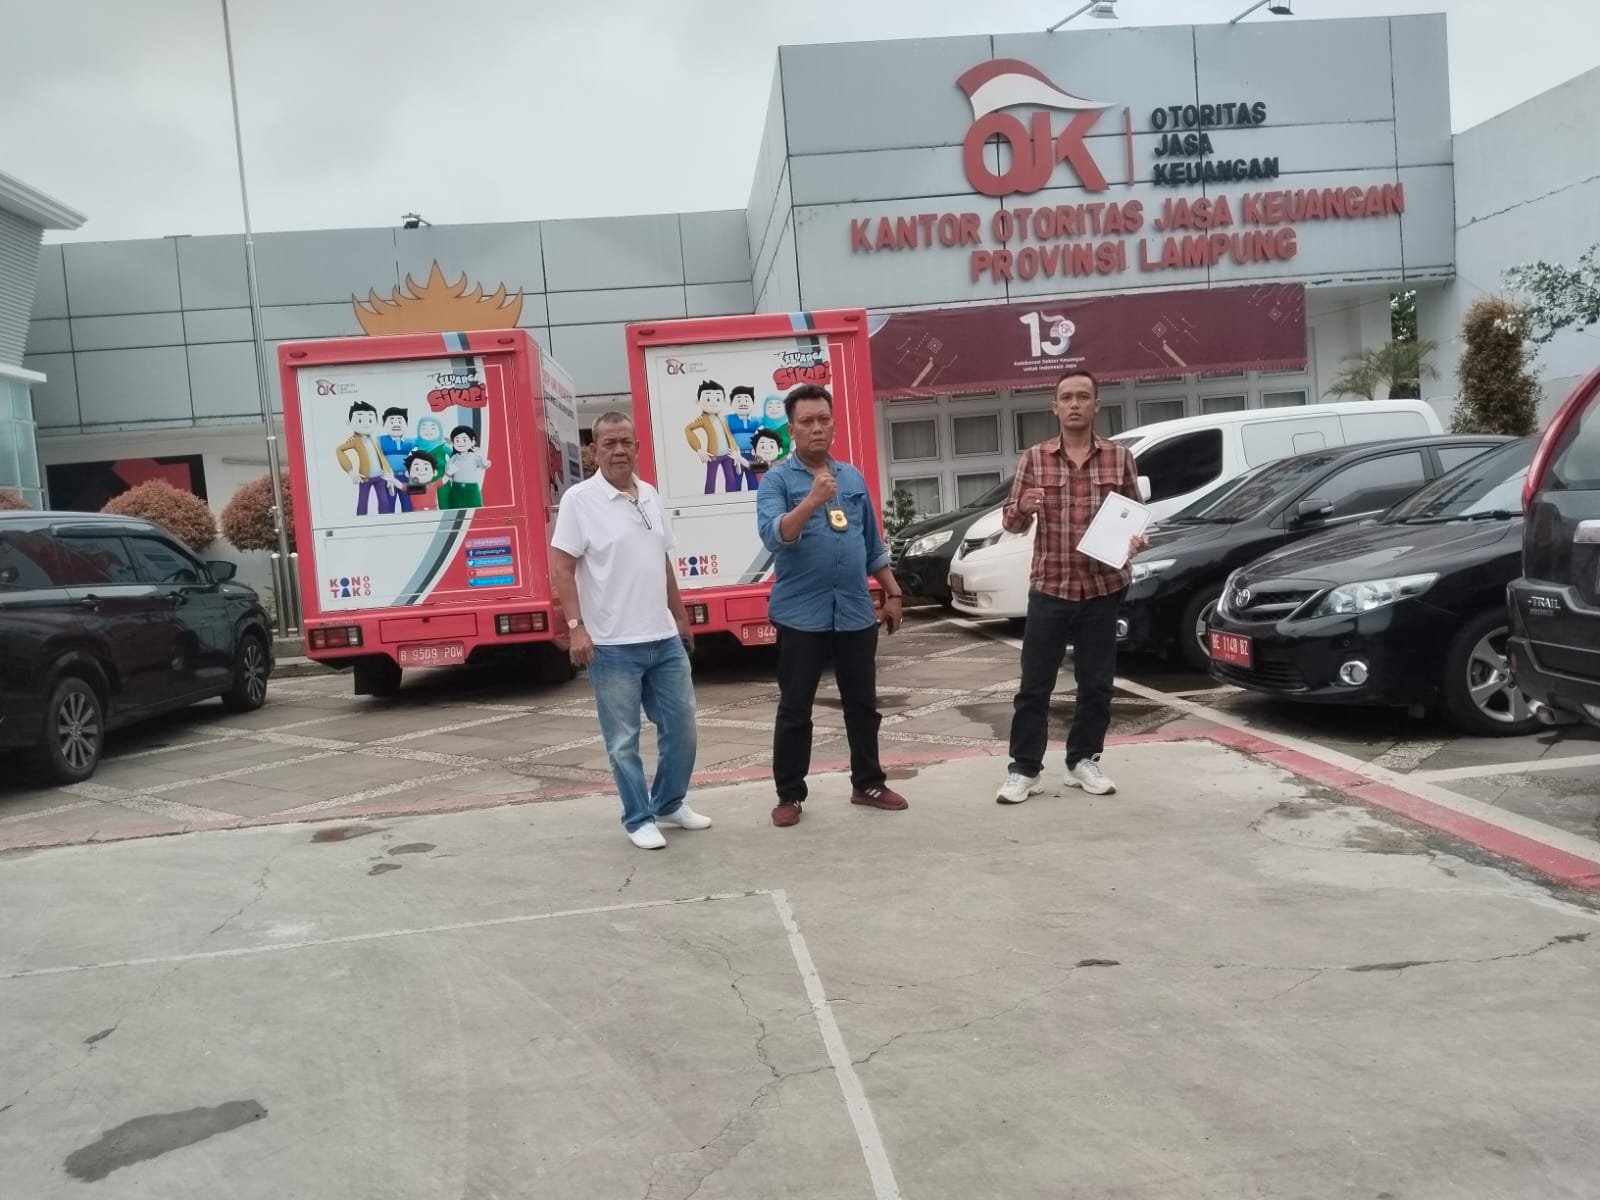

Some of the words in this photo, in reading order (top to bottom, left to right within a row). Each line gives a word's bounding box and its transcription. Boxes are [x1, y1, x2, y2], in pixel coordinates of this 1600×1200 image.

[1151, 101, 1267, 130] OTORITAS
[1154, 132, 1214, 157] JASA
[1153, 156, 1280, 187] KEUANGAN
[851, 211, 982, 253] KANTOR
[998, 199, 1144, 243] OTORITAS
[1154, 194, 1233, 232] JASA
[1243, 182, 1405, 225] KEUANGAN
[971, 239, 1126, 284] PROVINSI
[1141, 226, 1297, 272] LAMPUNG
[1019, 309, 1075, 357] 13
[757, 626, 777, 638] 944
[1212, 633, 1220, 649] BE
[400, 650, 407, 661] B
[412, 648, 437, 661] 9509
[444, 646, 463, 659] PQW
